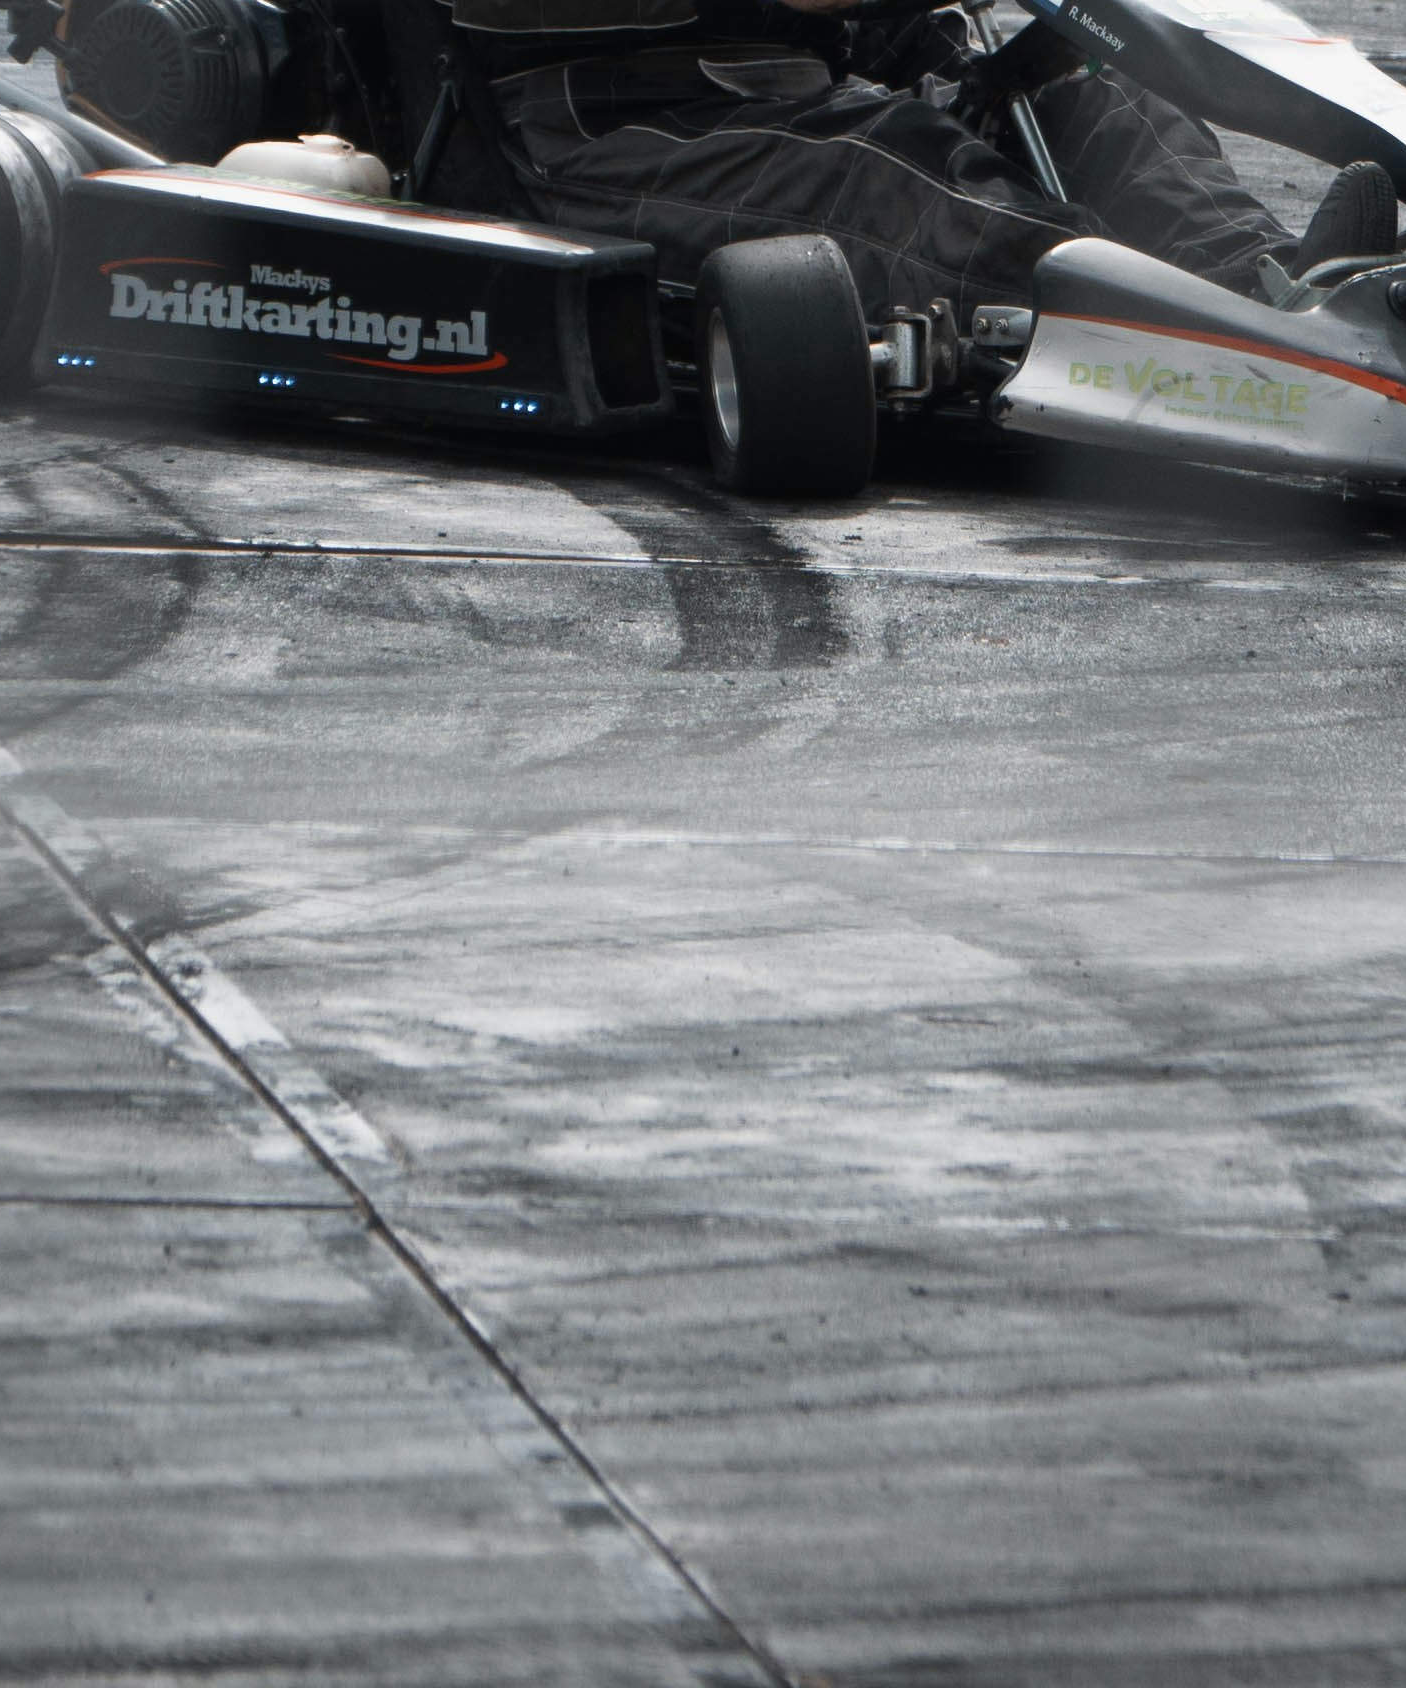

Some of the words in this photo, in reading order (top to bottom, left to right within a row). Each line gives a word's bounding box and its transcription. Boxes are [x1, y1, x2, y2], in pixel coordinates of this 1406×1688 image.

[1068, 5, 1079, 21] R.
[1080, 13, 1125, 52] Mackaay
[250, 264, 332, 295] Mackys
[109, 273, 489, 361] Driftkarting.nl
[1069, 361, 1115, 390] DE
[1124, 356, 1311, 417] VOLTAGE
